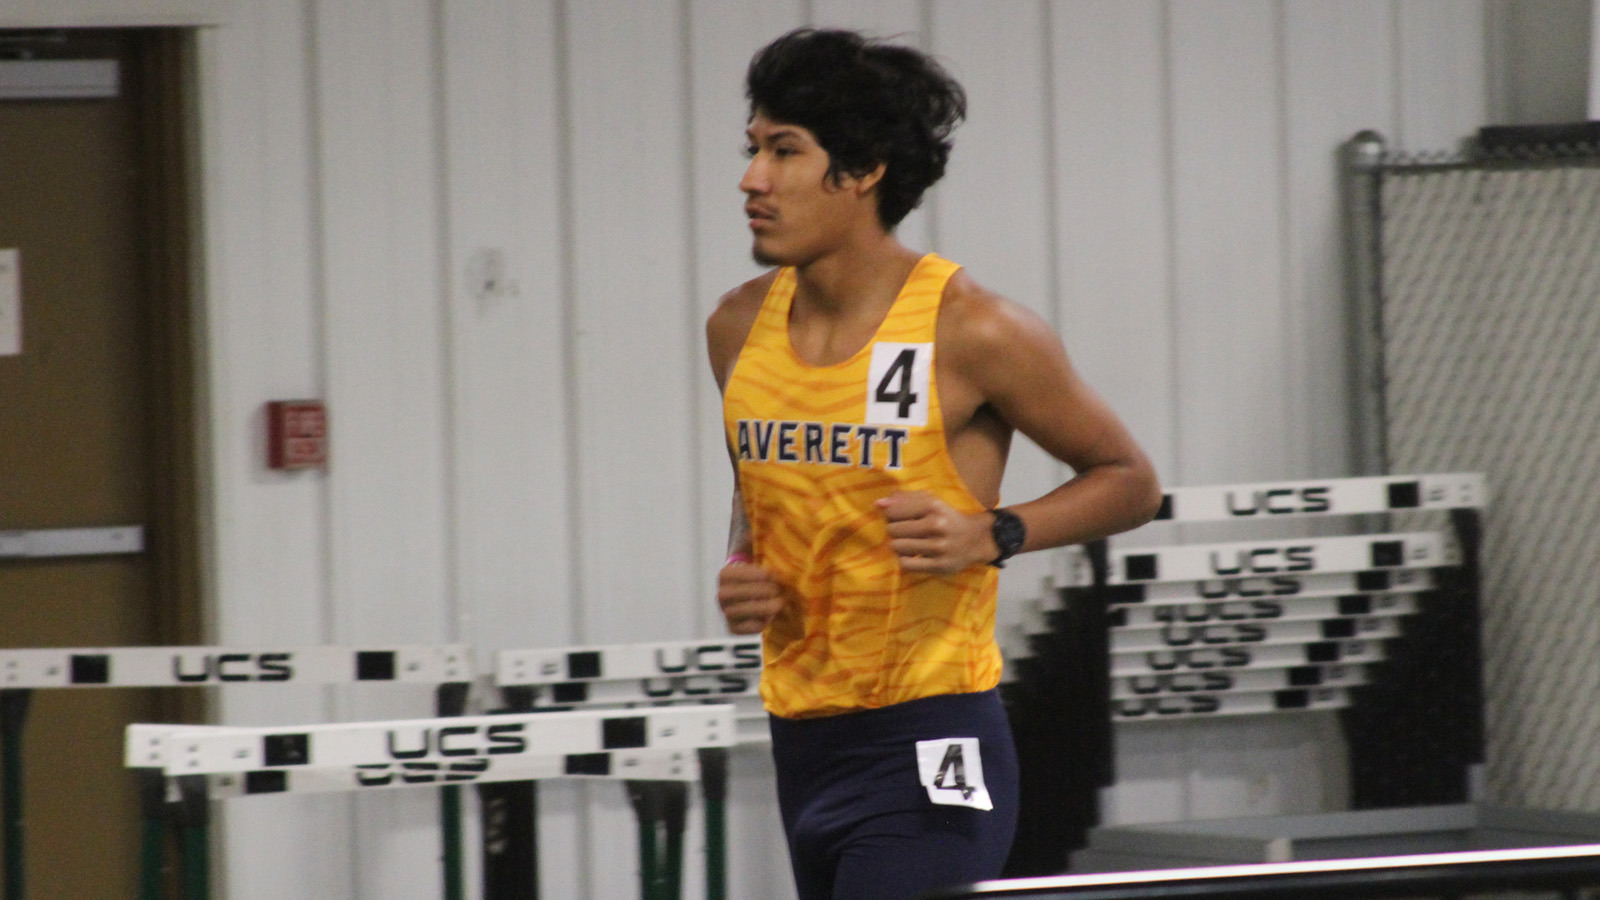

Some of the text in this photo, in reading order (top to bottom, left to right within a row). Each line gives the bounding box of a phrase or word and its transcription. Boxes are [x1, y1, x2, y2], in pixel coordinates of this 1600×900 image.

[875, 348, 918, 418] 4
[736, 419, 909, 469] AVERETT
[1227, 487, 1331, 515] UCS
[1212, 545, 1315, 575] UCS
[173, 653, 293, 682] UCS
[655, 643, 762, 673] UCS
[386, 723, 528, 759] UCS
[933, 744, 976, 801] 4
